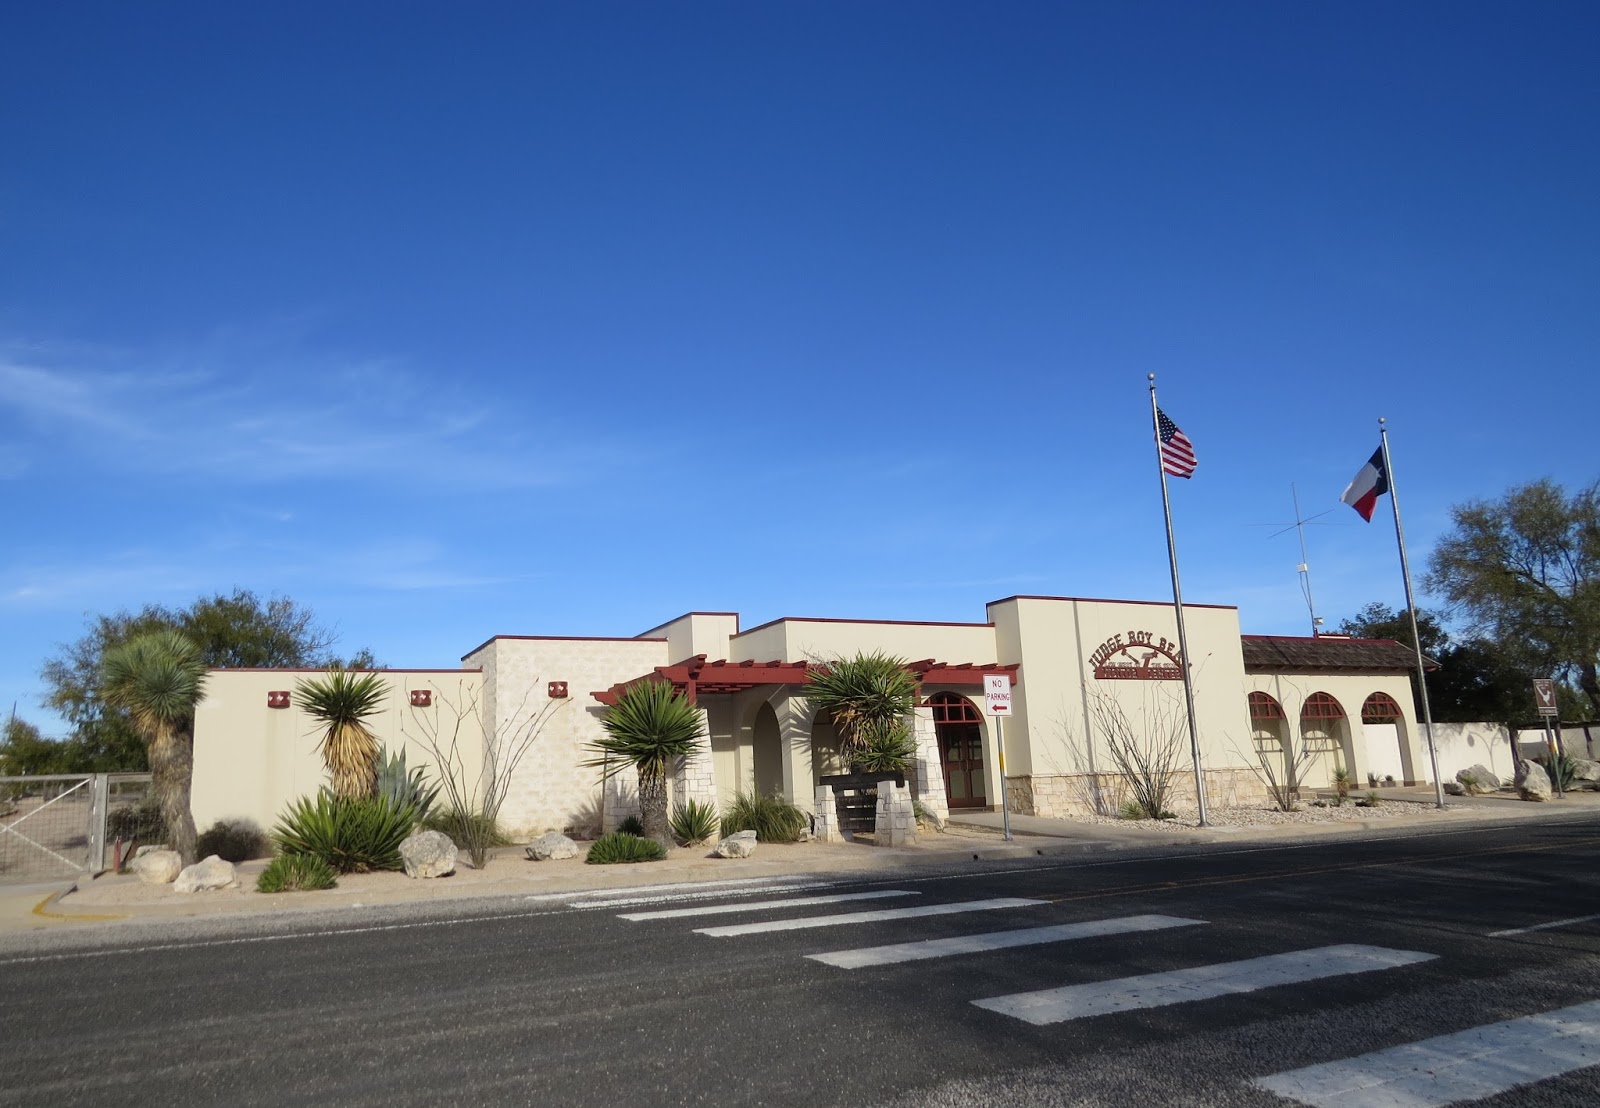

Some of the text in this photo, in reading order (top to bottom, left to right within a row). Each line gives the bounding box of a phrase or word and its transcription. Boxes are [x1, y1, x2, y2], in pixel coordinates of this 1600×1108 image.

[1088, 630, 1187, 668] JUDGE ROY BEA
[992, 679, 1002, 688] NO
[986, 692, 1010, 701] PARKING
